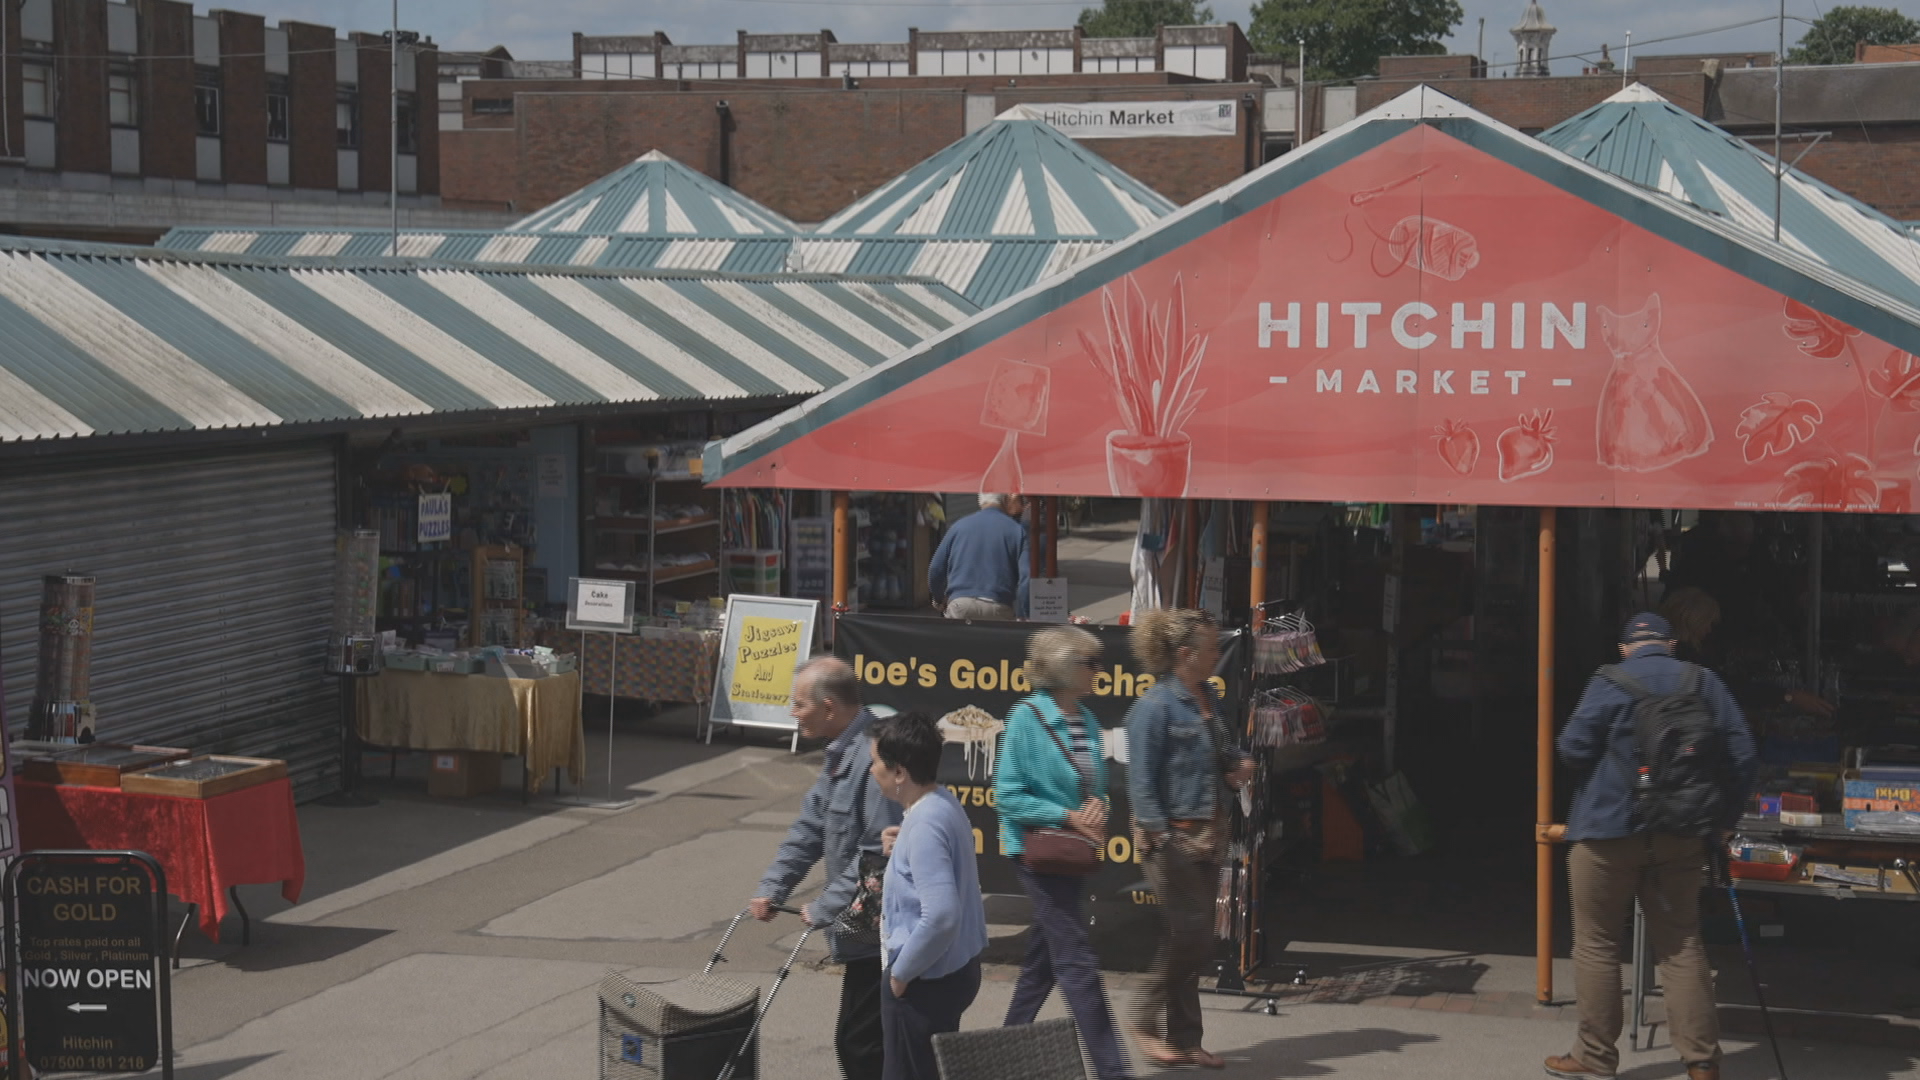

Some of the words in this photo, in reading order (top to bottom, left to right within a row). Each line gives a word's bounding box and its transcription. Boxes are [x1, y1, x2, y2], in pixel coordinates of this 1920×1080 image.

[1044, 110, 1103, 127] Hitchin
[1110, 109, 1174, 125] Market
[1258, 301, 1586, 350] HITCHIN
[1315, 368, 1526, 395] MARKET
[418, 520, 450, 538] PUZZLES
[591, 590, 609, 599] Cake
[745, 624, 798, 643] Jigsaw
[739, 642, 798, 664] Puzzles
[753, 664, 774, 682] And
[950, 659, 1031, 692] Gold
[731, 683, 790, 703] Stationery
[27, 877, 89, 895] CASH
[96, 877, 142, 895] FOR
[53, 903, 117, 921] GOLD
[32, 938, 50, 948] Top
[53, 938, 81, 947] rates
[84, 938, 109, 949] paid
[111, 938, 125, 947] on
[127, 938, 141, 947] all
[25, 952, 50, 961] Gold
[60, 951, 91, 961] Silver
[101, 951, 149, 961] Platinum
[24, 968, 81, 988] NOW
[86, 969, 151, 989] OPEN
[63, 1037, 113, 1050] Hitchin
[40, 1057, 85, 1070] 07500
[89, 1057, 113, 1069] 181
[118, 1056, 144, 1069] 218
